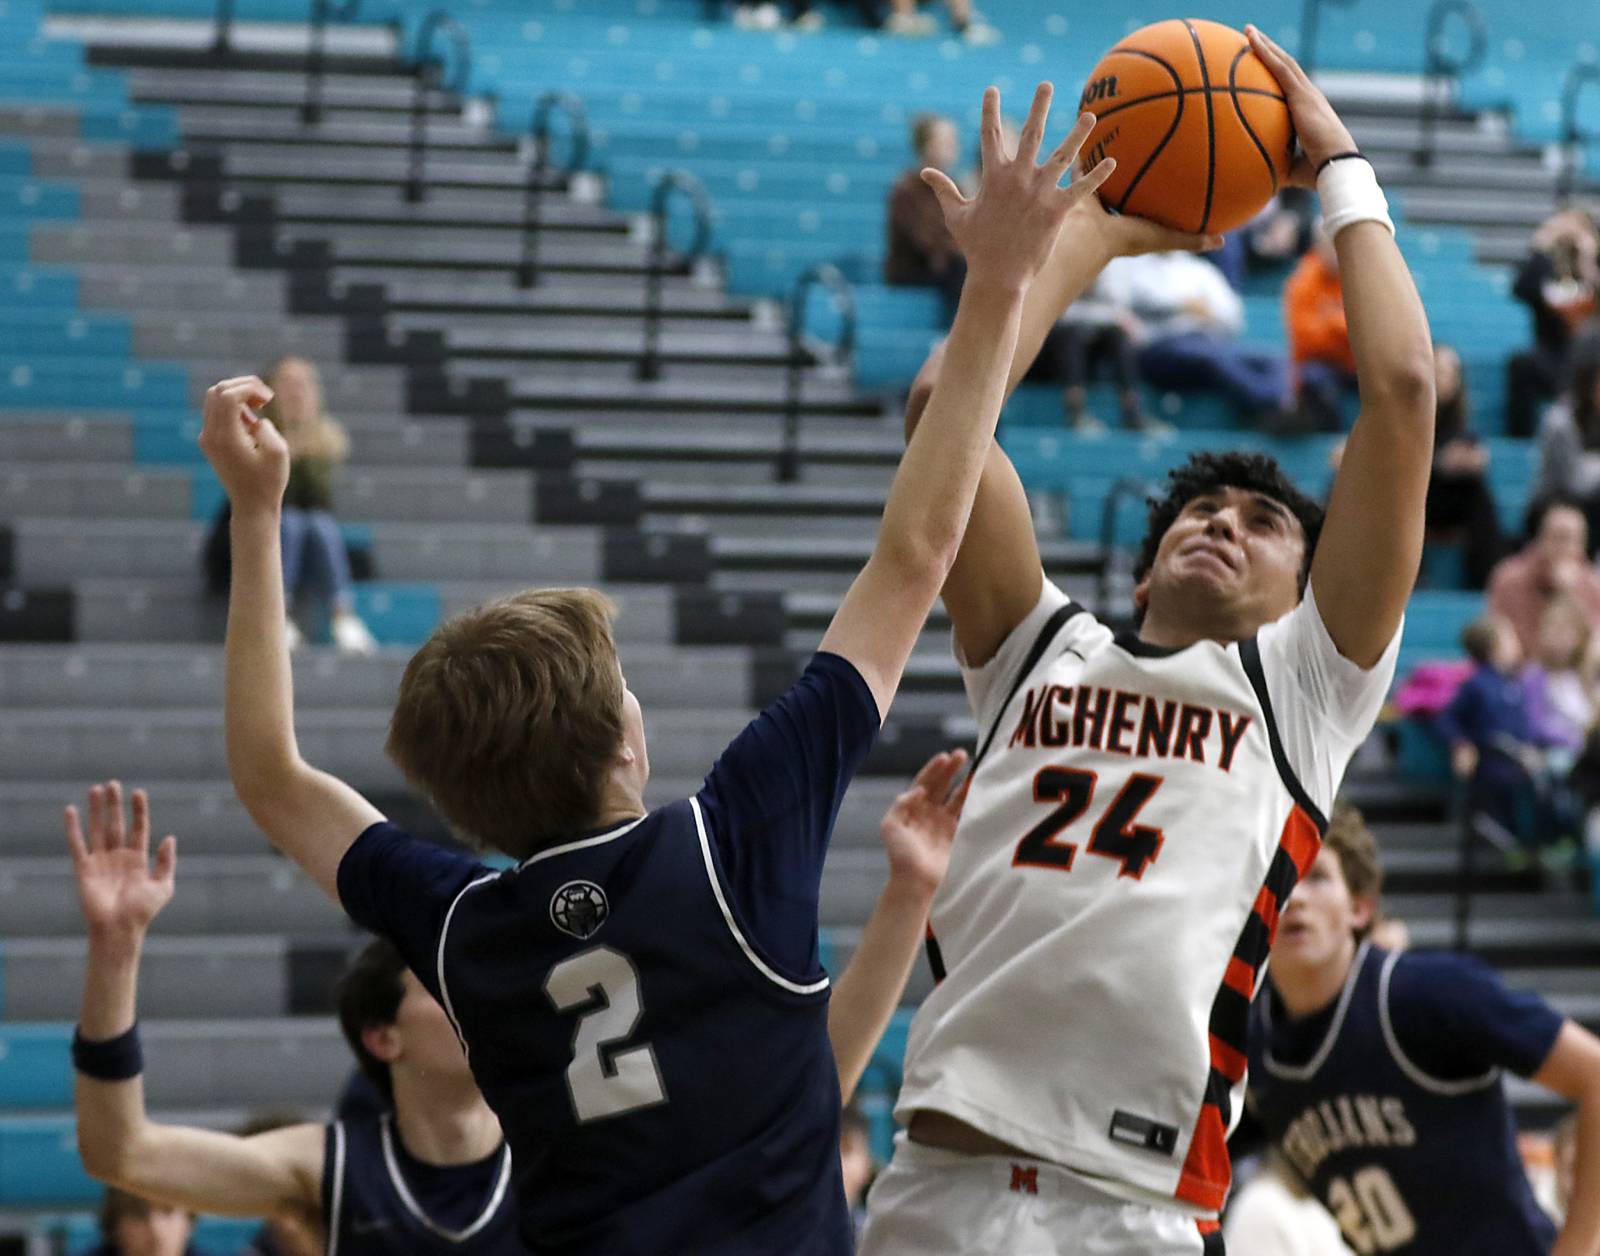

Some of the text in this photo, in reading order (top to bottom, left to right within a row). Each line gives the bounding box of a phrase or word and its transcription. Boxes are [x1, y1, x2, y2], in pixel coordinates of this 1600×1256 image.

[1008, 684, 1253, 773] MCHENRY
[1012, 764, 1165, 880] 24
[543, 945, 668, 1124] 2
[1010, 1163, 1039, 1195] M
[1327, 1165, 1416, 1254] 20
